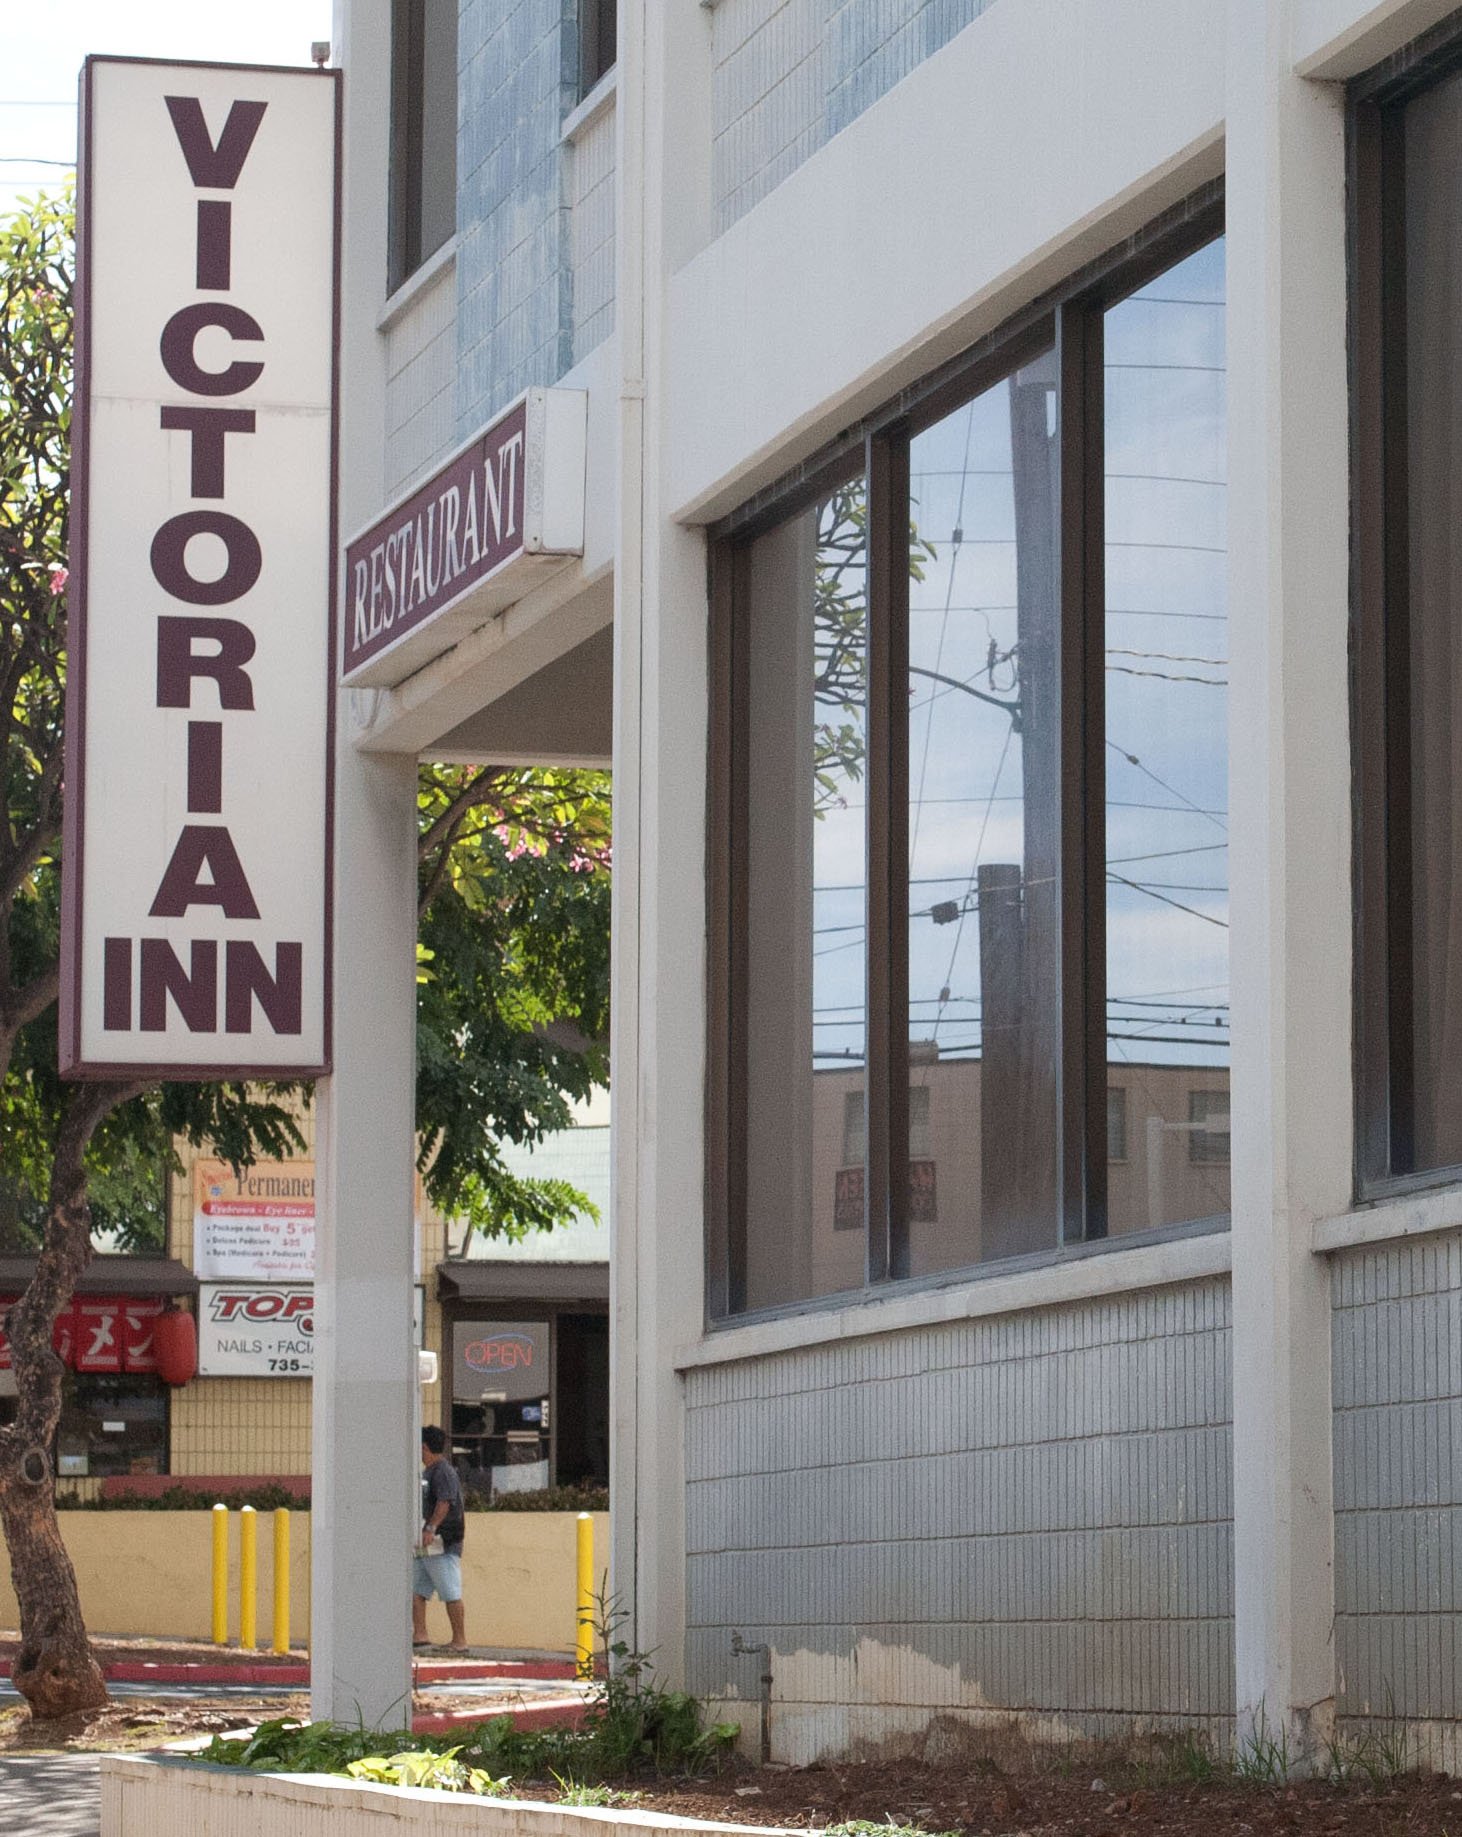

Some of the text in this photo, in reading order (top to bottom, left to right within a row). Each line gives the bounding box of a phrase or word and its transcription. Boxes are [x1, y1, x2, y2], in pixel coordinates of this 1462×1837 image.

[148, 95, 268, 919] VICTORIA
[352, 430, 523, 652] RESTAURANT
[103, 937, 303, 1035] INN
[263, 1223, 280, 1234] Buy
[217, 1340, 263, 1354] NAILS
[465, 1341, 532, 1366] OPEN
[267, 1359, 314, 1372] 735-
